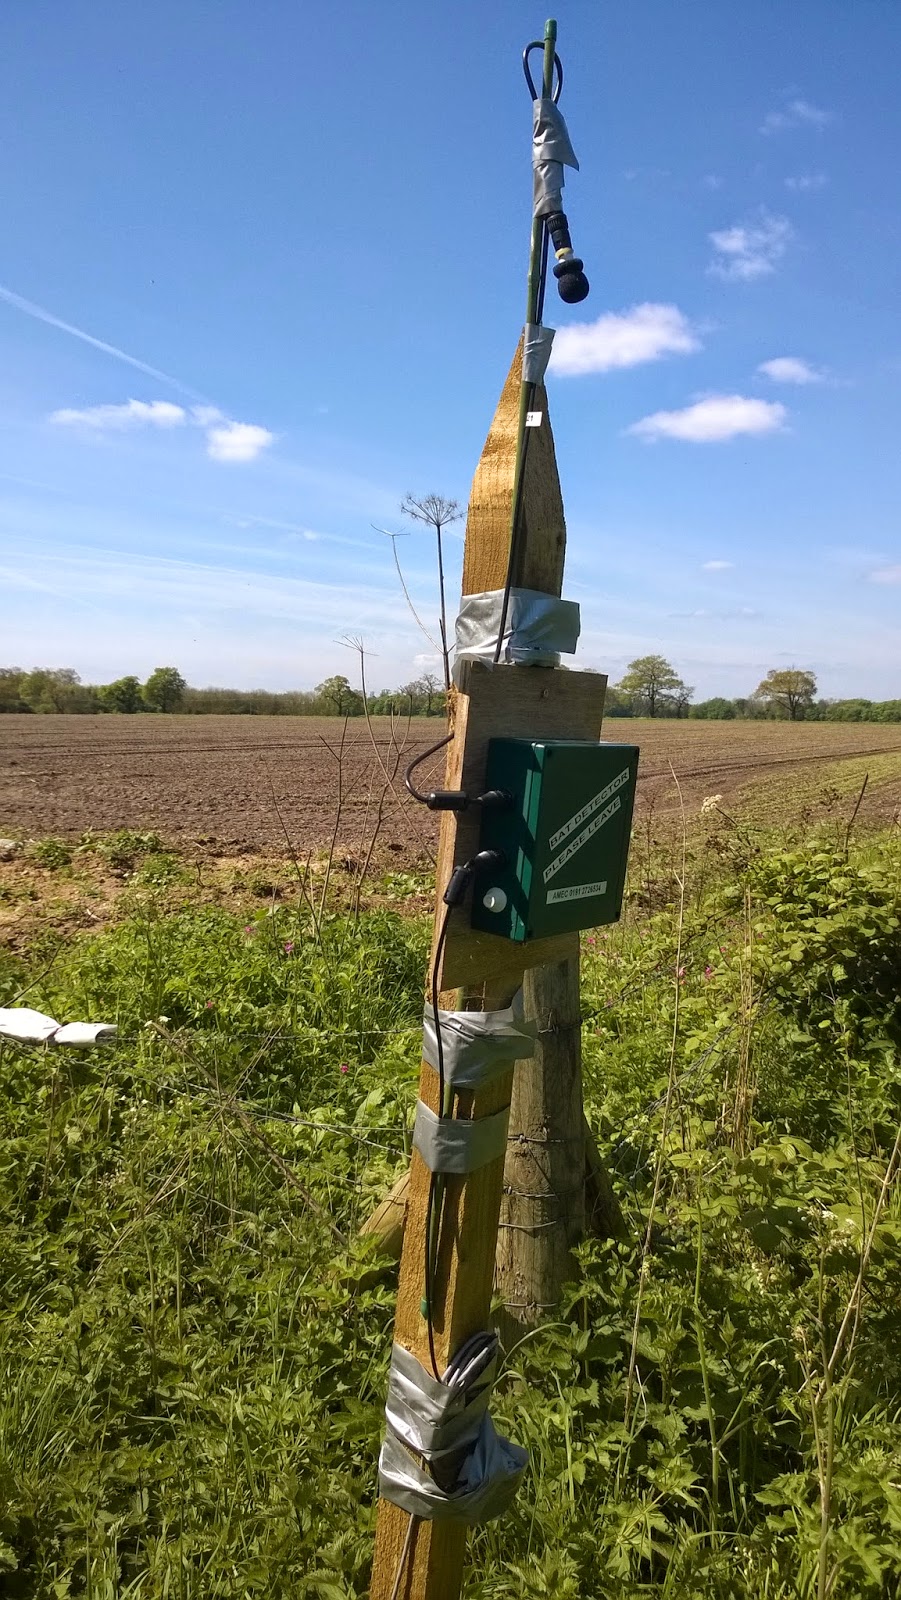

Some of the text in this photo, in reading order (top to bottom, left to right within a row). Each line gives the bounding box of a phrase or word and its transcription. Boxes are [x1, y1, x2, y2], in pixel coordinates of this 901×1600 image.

[545, 799, 620, 879] PLEASE LEAVE
[551, 772, 628, 847] BAT DETECTOR
[552, 890, 568, 900] AMEC
